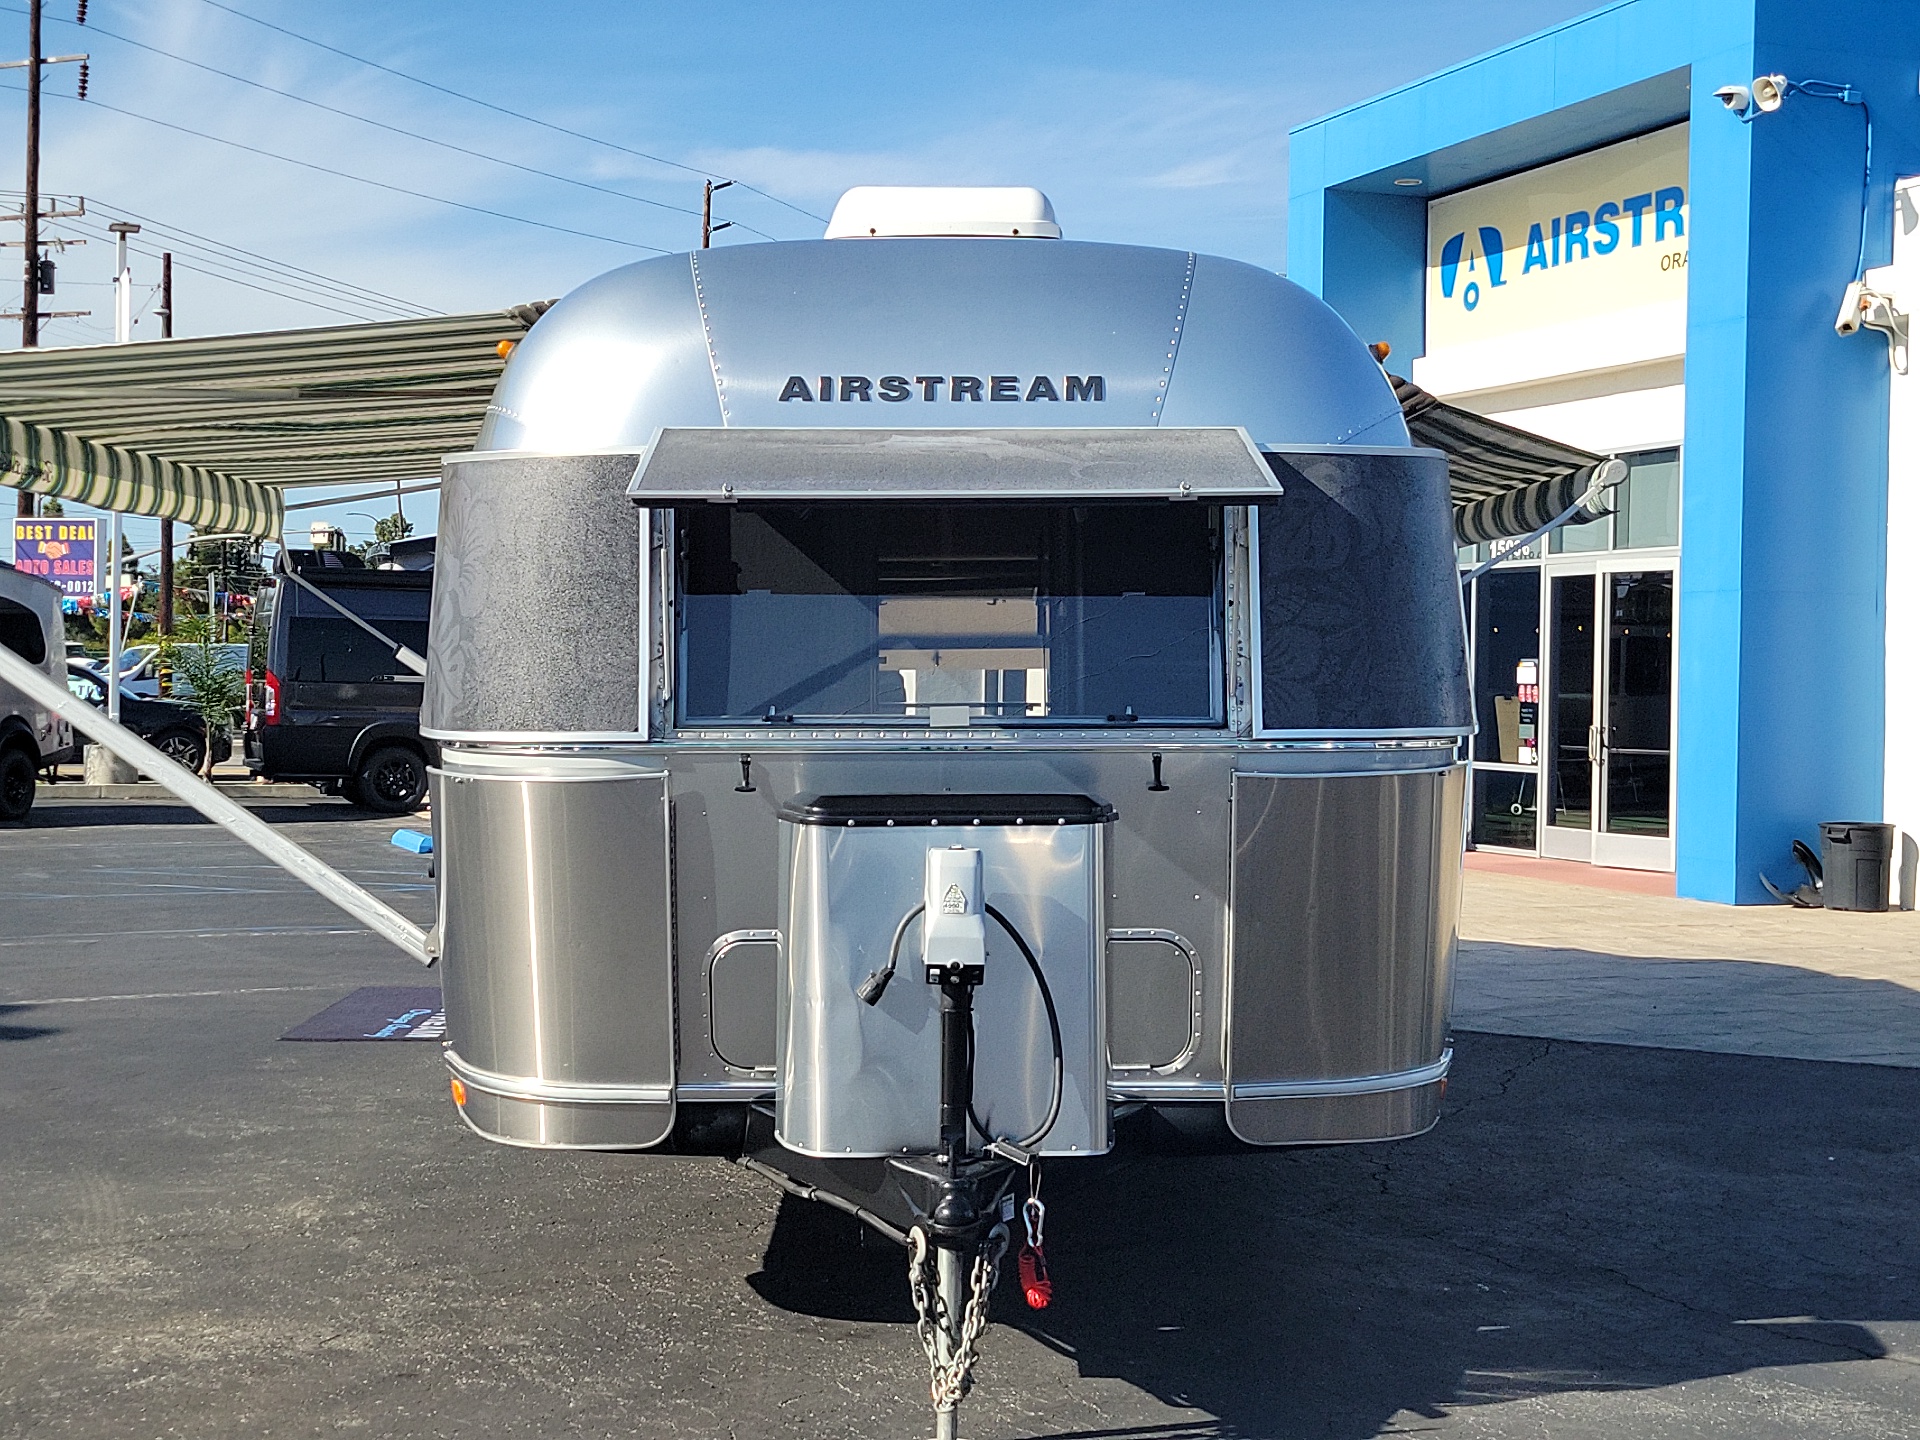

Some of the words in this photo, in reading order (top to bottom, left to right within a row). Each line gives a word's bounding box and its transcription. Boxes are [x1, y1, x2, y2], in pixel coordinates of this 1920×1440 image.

[1522, 186, 1685, 275] AIRSTR
[778, 375, 1105, 402] AIRSTREAM
[16, 525, 53, 540] BEST
[59, 525, 94, 540] DEAL
[15, 559, 49, 575] AUTO
[53, 560, 94, 575] SALES
